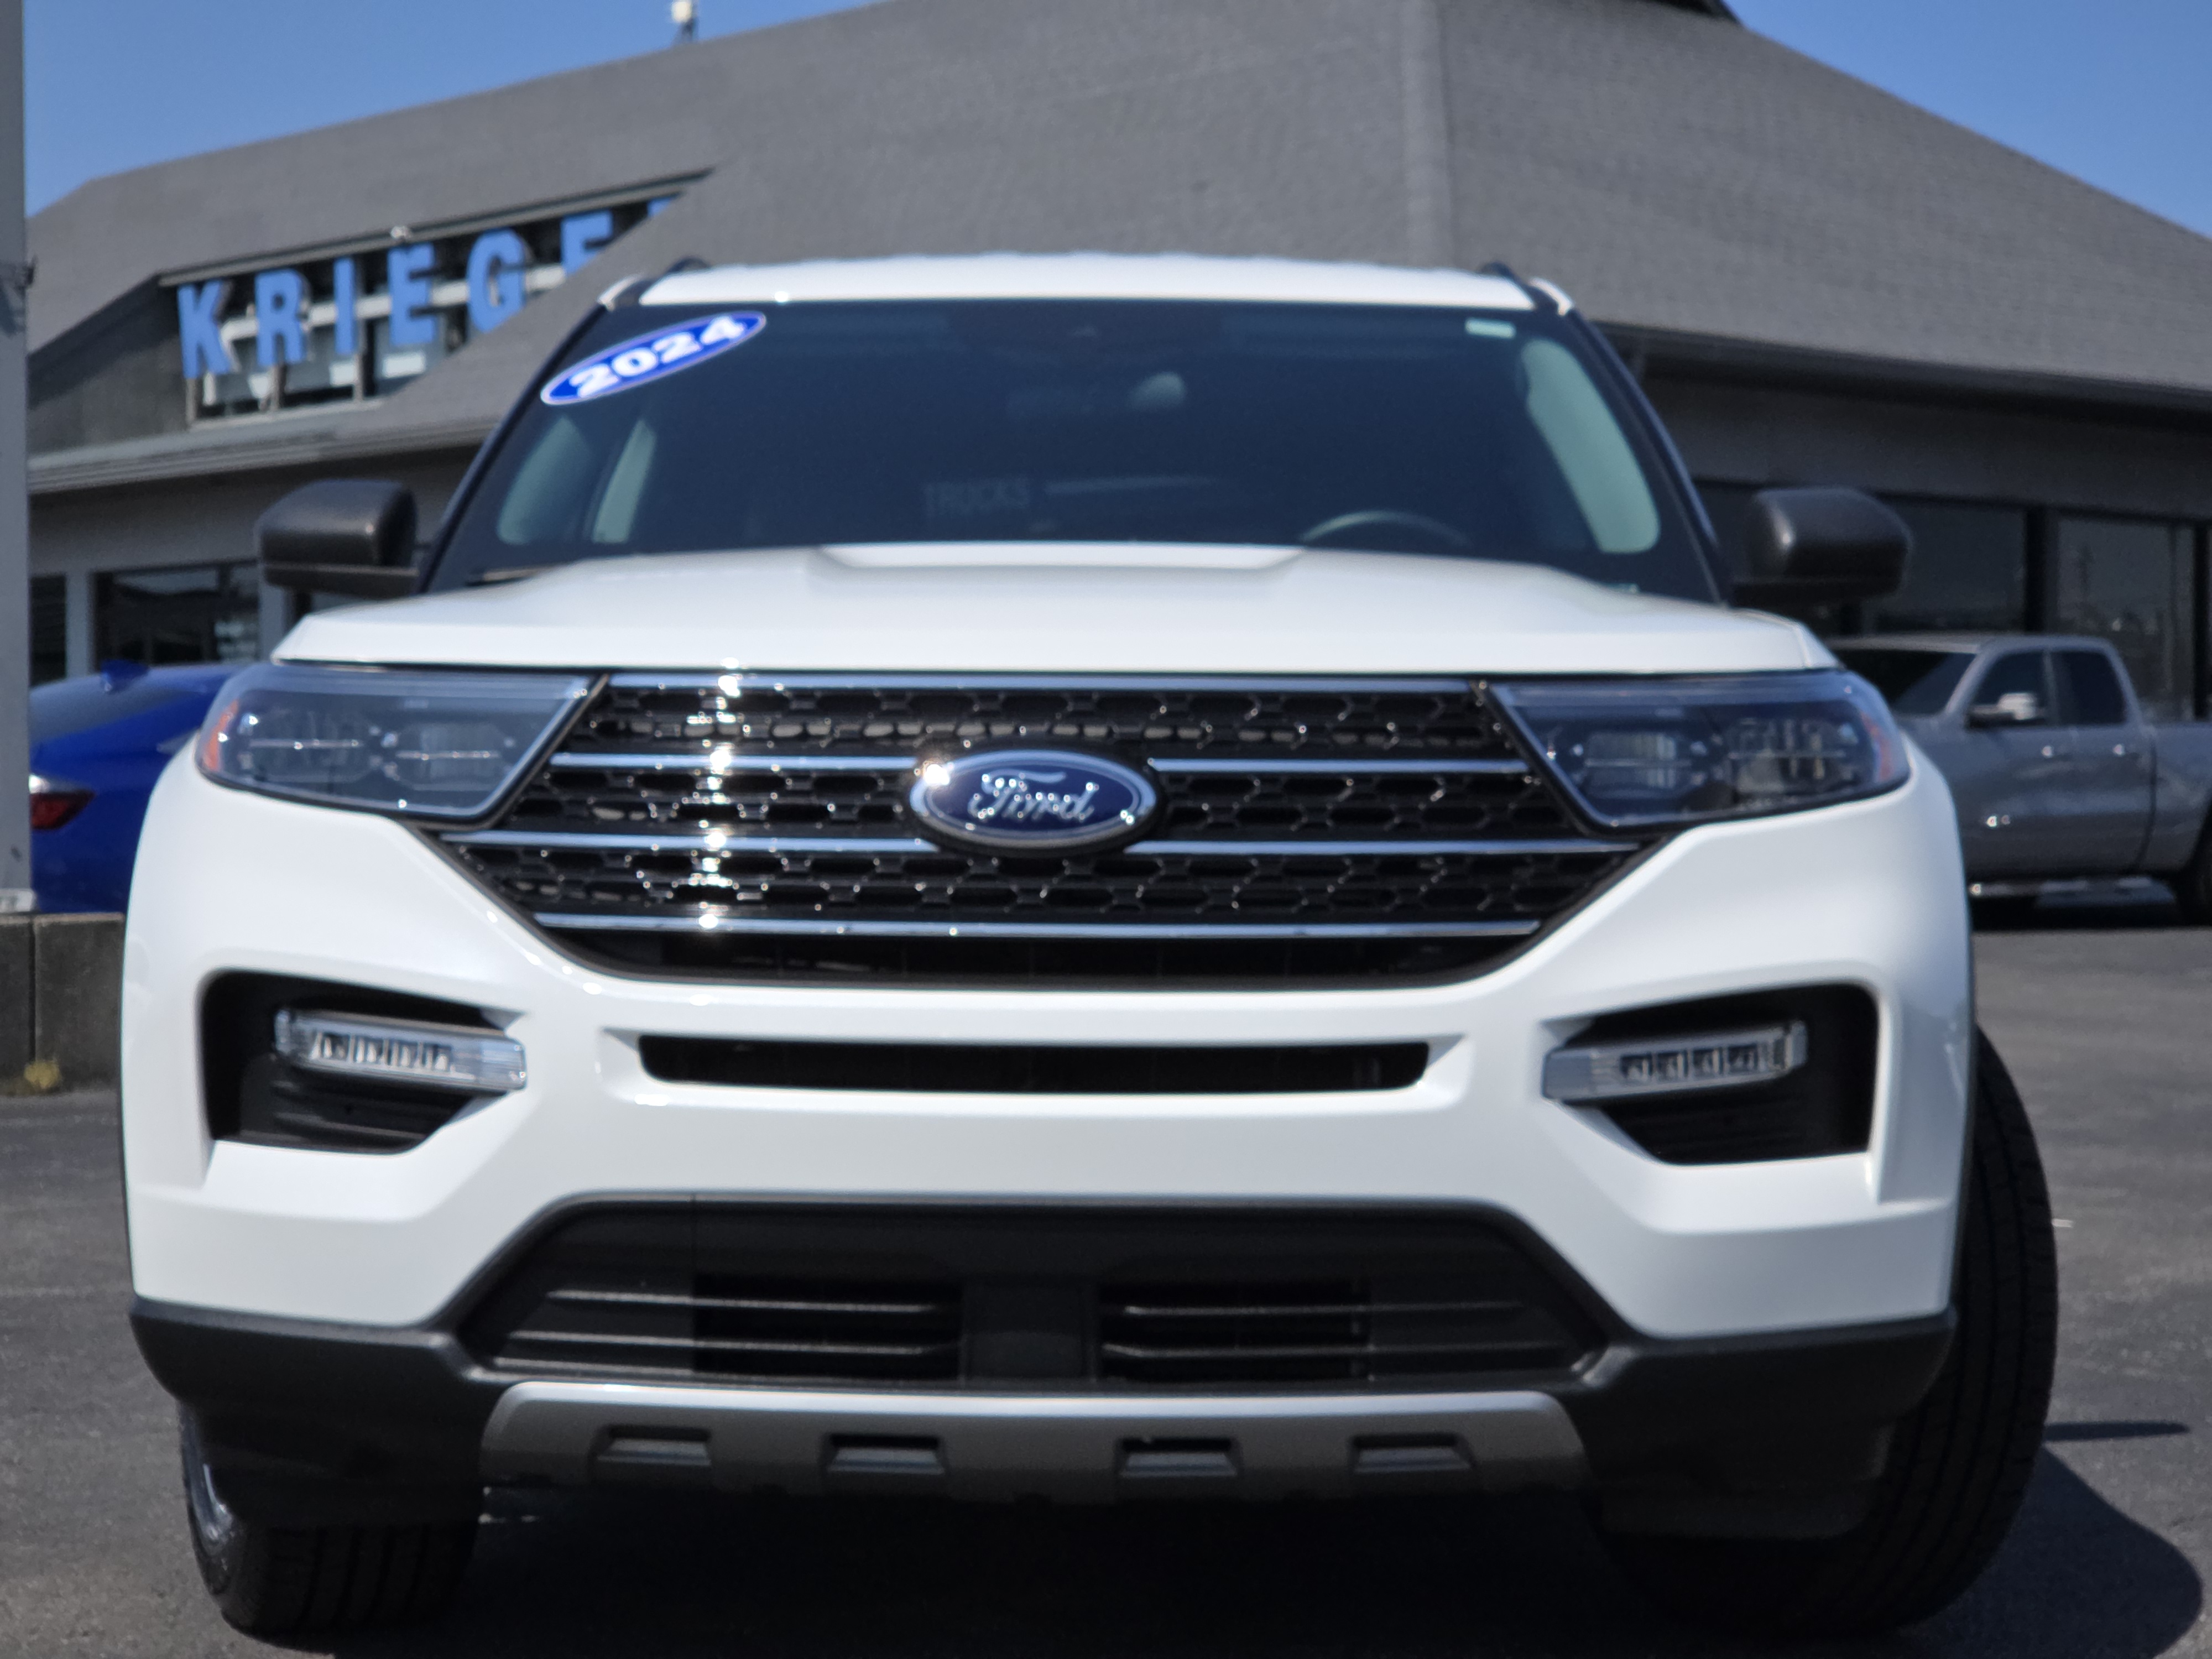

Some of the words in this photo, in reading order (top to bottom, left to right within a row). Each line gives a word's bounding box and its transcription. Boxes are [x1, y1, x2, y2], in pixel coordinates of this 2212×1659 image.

[178, 198, 671, 378] KRIEGE
[569, 316, 745, 399] 2024
[967, 770, 1095, 821] Ford
